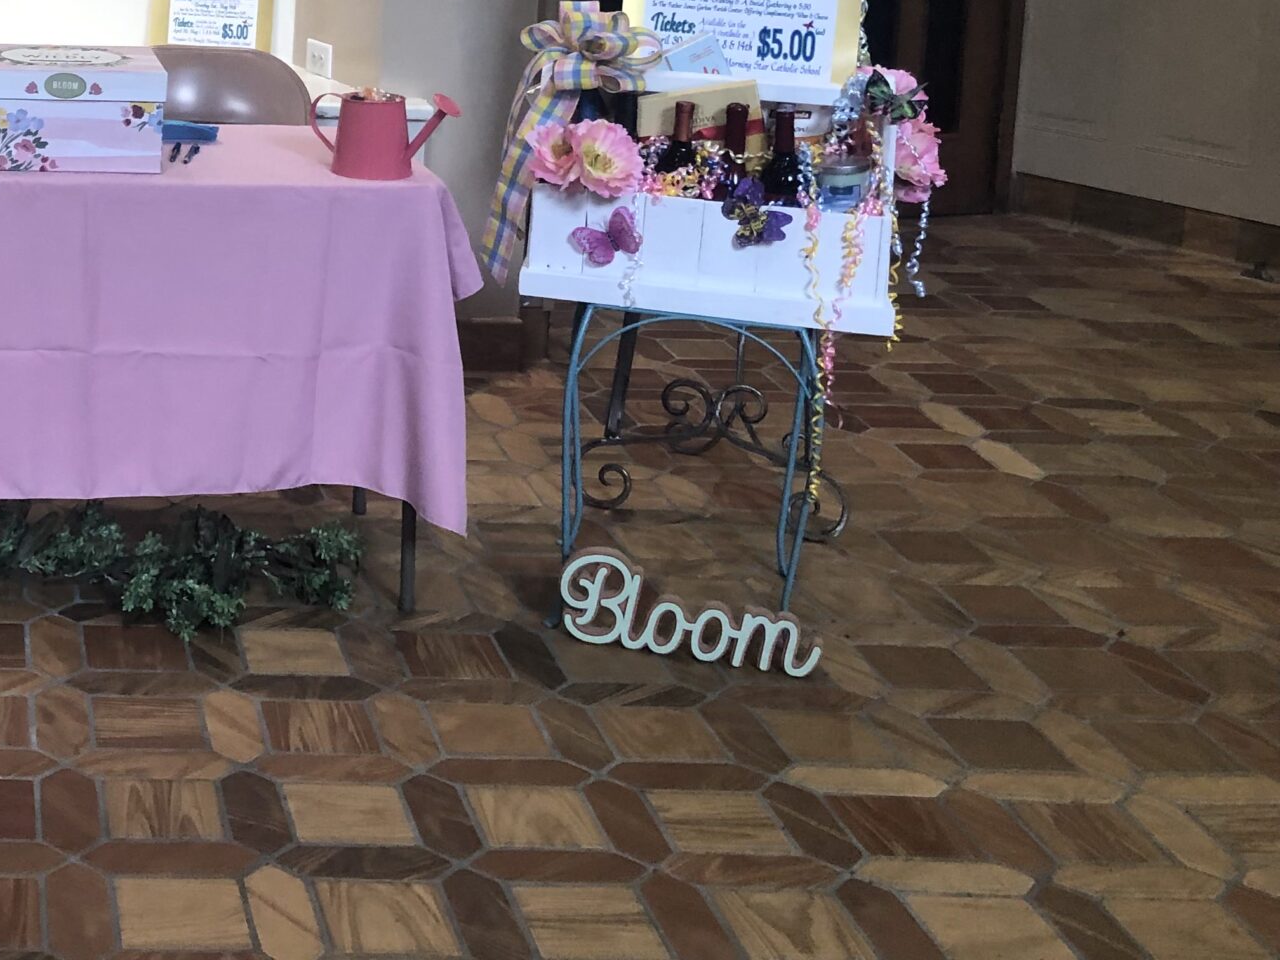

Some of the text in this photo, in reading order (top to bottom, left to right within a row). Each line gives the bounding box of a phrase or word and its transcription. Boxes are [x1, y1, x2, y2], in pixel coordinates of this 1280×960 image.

[222, 22, 249, 40] $5.00
[650, 11, 696, 35] Tickets:
[756, 26, 816, 62] $5.00
[52, 80, 79, 90] BLOOM
[560, 551, 821, 678] Bloom
